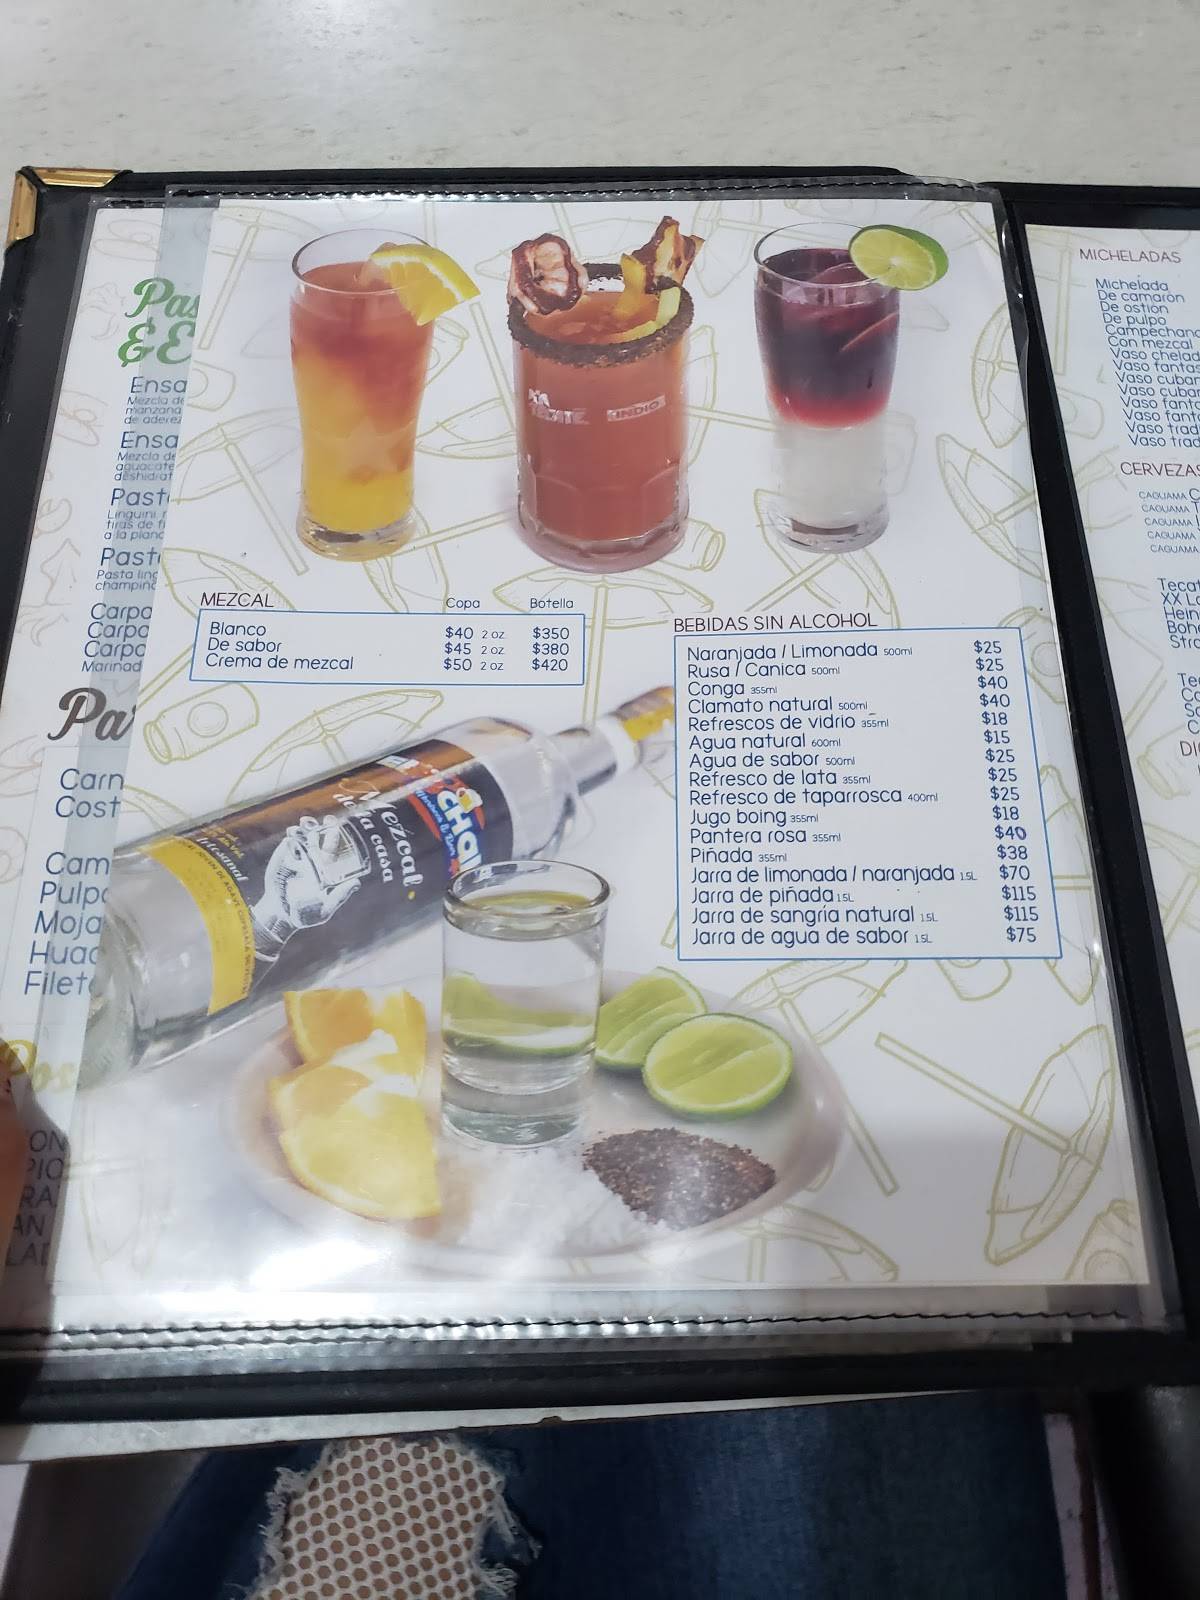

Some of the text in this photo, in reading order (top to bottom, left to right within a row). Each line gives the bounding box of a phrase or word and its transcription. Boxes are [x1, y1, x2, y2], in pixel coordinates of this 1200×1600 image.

[1080, 249, 1181, 263] MICHELADAS
[1096, 278, 1168, 291] Michelada
[1098, 290, 1116, 301] De
[1100, 301, 1119, 312] De
[1103, 313, 1166, 326] De pulpo
[1108, 336, 1193, 349] Con mezcal
[1110, 348, 1146, 359] Vaso
[1113, 359, 1149, 371] Vaso
[1115, 371, 1152, 383] Vaso
[1118, 383, 1154, 395] Vaso
[1120, 396, 1157, 408] Vaso
[1123, 408, 1160, 421] Vaso
[1125, 421, 1163, 433] Vaso
[1128, 433, 1165, 447] Vaso
[1139, 491, 1186, 500] CAGUAMA
[1142, 504, 1190, 513] CAGUAMA
[1145, 517, 1193, 526] CAGUAMA
[1148, 531, 1195, 540] CAGUAMA
[1150, 545, 1199, 553] CAGUAMA
[97, 570, 133, 580] Pasta
[200, 592, 573, 610] MEZCAL Copa Botella
[1161, 592, 1182, 605] XX
[210, 622, 266, 636] Blanco
[445, 627, 473, 640] $40
[482, 630, 488, 639] 2
[533, 627, 569, 640] $350
[674, 613, 877, 632] BEBIDAS SIN ALCOHOL
[208, 637, 569, 656] De sabor $45 2 oz $380
[688, 646, 776, 663] Naranjada
[791, 643, 877, 659] Limonada
[883, 647, 912, 656] 500ml
[974, 641, 1001, 654] $25
[206, 653, 568, 672] Crema de mezcal $50 2 oz $420
[688, 664, 729, 678] Rusa
[746, 662, 806, 676] Canica
[811, 667, 840, 675] 500ml
[976, 658, 1004, 672] $25
[688, 677, 1008, 699] Conga 355ml $40
[688, 694, 1010, 713] Clamato natural 500ml $40
[688, 712, 1008, 731] Refrescos de vidrio 355ml $18
[689, 731, 1010, 753] Agua natural 600ml $15
[689, 749, 1015, 771] Agua de sabor 500ml $25
[689, 768, 1017, 786] Refresco de lata 355ml $25
[690, 787, 1019, 806] Refresco de taparrosca 400ml $25
[690, 806, 1019, 828] Jugo boing 355ml $18
[691, 826, 1026, 844] Pantera rosa 355ml $40
[370, 834, 393, 882] casa
[691, 846, 1027, 863] Piñada 355ml $38
[691, 868, 732, 883] Jarra
[736, 867, 759, 883] de
[765, 866, 847, 882] limonada
[862, 864, 954, 885] naranjada
[999, 866, 1030, 881] $70
[691, 888, 732, 904] Jarra
[737, 888, 762, 903] de
[770, 887, 833, 906] piñada
[1002, 886, 1036, 901] $115
[692, 908, 735, 924] Jarra
[741, 908, 763, 923] de
[770, 905, 839, 926] sangría
[846, 906, 914, 922] natural
[1004, 906, 1038, 921] $115
[692, 929, 735, 945] Jarra
[741, 928, 764, 943] de
[772, 930, 821, 948] agua
[826, 927, 849, 942] de
[857, 926, 908, 943] sabor
[1006, 927, 1036, 942] $75
